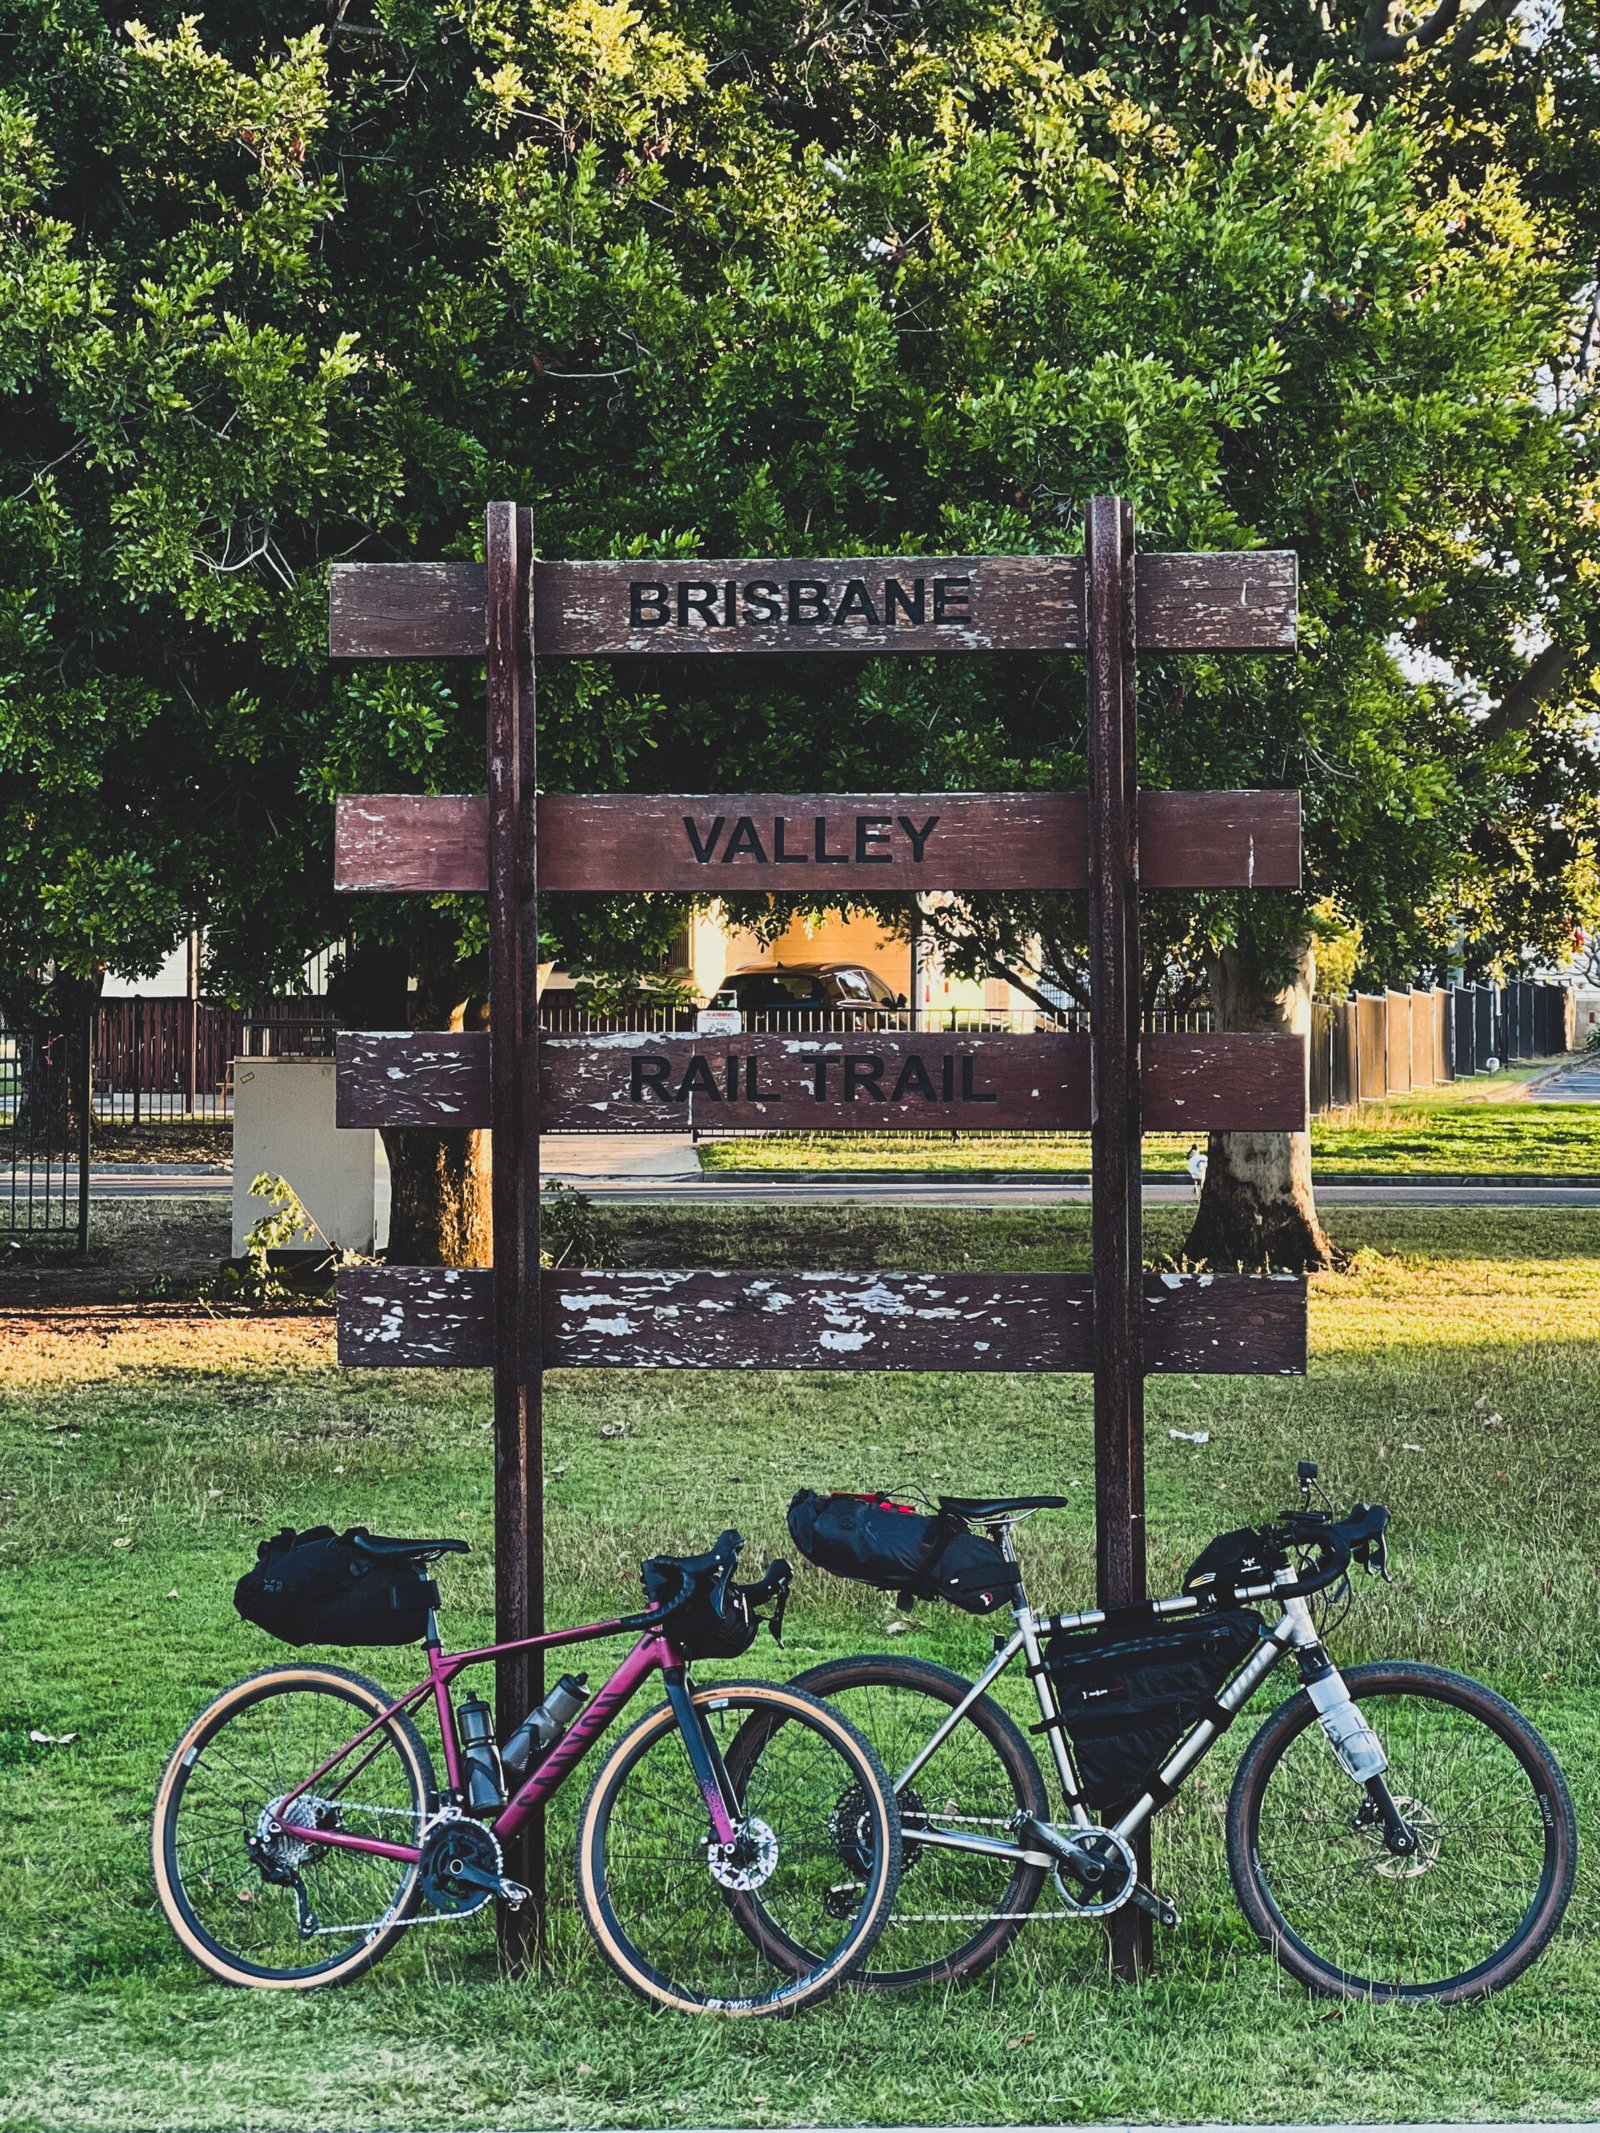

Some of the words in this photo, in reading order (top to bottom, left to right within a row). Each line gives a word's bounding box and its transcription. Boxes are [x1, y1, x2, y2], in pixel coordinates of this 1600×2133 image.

[629, 577, 972, 627] BRISBANE
[682, 816, 940, 864] VALLEY
[630, 1055, 781, 1102] RAIL
[801, 1054, 998, 1103] TRAIL
[516, 1692, 624, 1808] CANYON
[1542, 1801, 1554, 1828] HUNT
